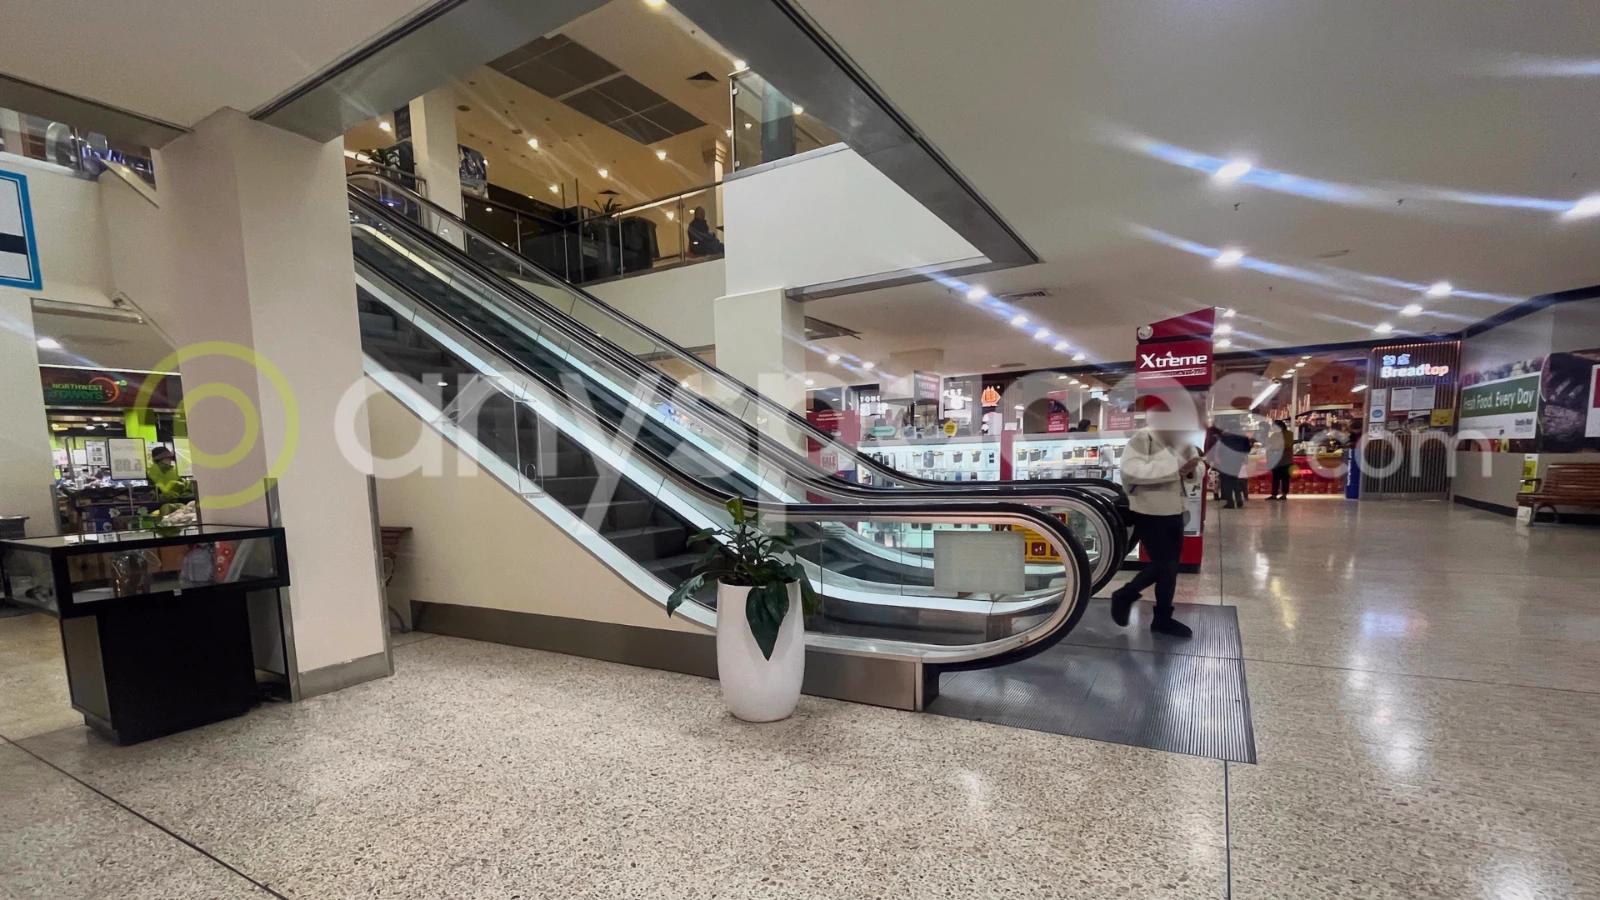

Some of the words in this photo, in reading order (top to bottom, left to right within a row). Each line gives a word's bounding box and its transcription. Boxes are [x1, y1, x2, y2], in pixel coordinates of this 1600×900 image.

[1140, 351, 1208, 369] Xtreme
[1381, 363, 1449, 378] Breadtop
[52, 383, 103, 391] NORTHWEST
[1495, 391, 1516, 409] Every
[1517, 388, 1535, 408] Day
